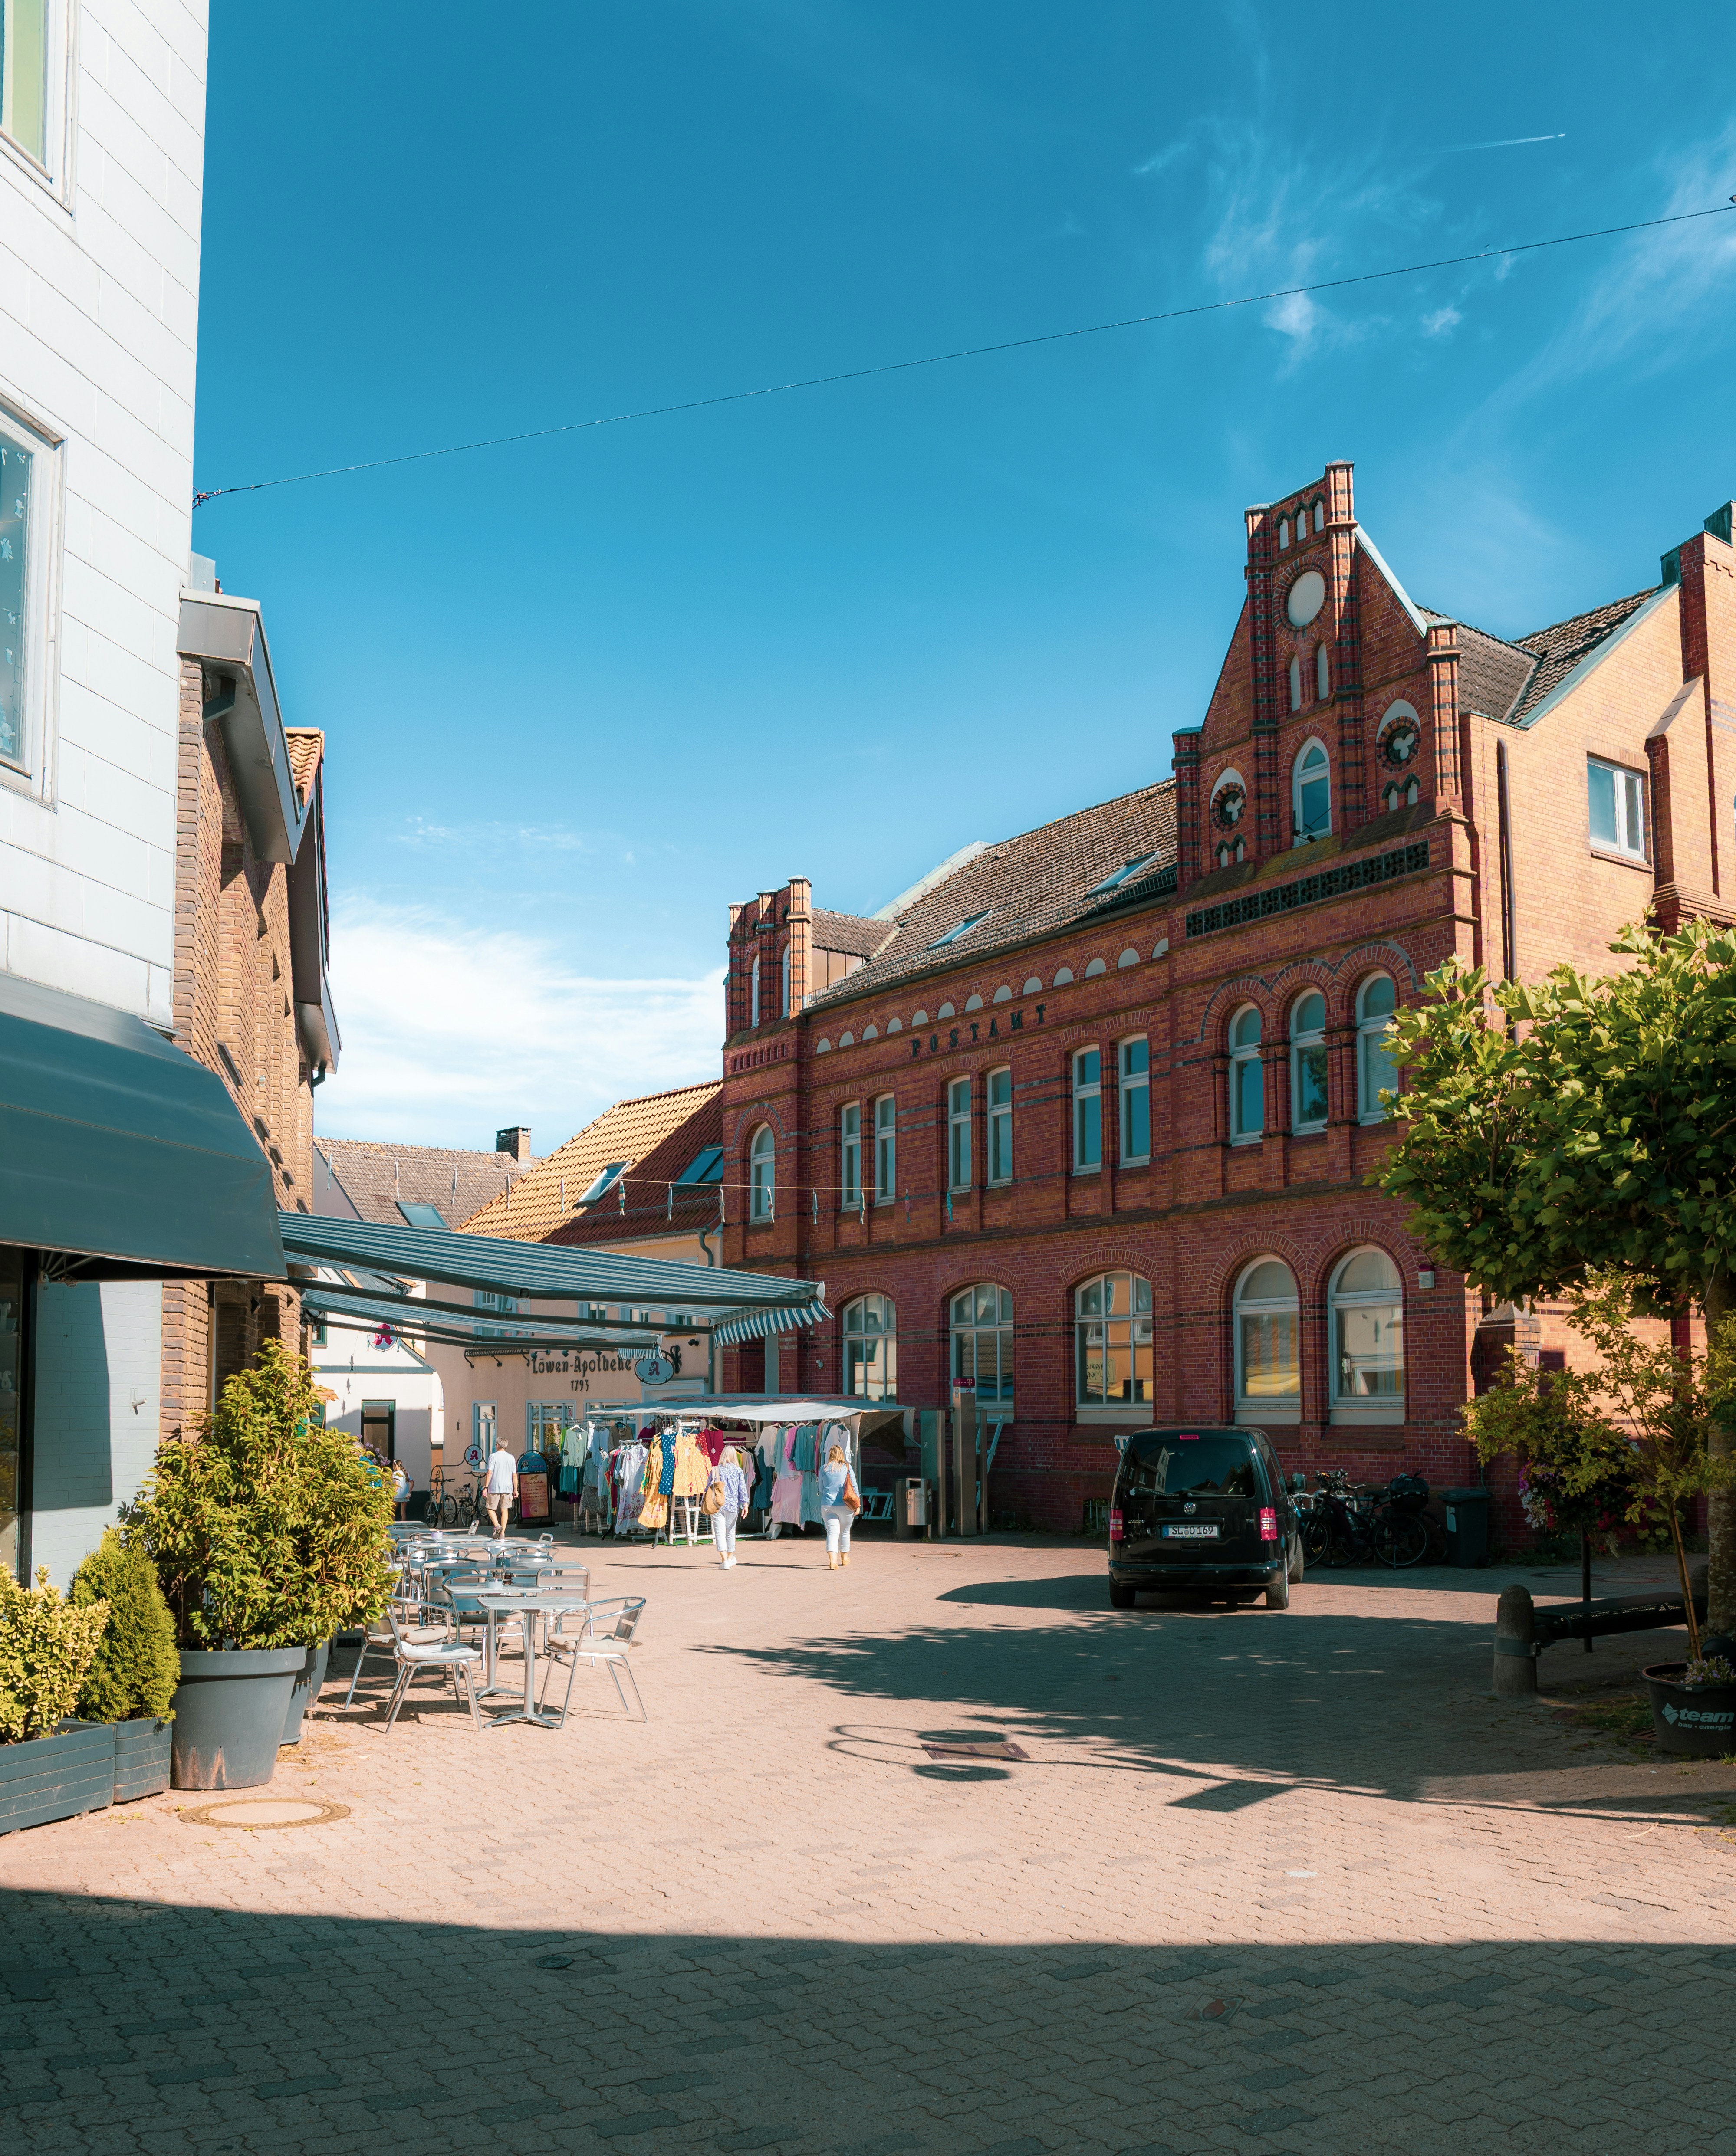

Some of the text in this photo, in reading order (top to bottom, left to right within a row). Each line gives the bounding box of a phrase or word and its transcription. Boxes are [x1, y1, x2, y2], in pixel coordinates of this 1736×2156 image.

[911, 1004, 1046, 1057] POSTAMT
[531, 1354, 631, 1378] Löwen-Apotheke
[570, 1379, 589, 1392] 1793
[1172, 1526, 1184, 1535] SL
[1197, 1526, 1213, 1535] 169
[1679, 1708, 1735, 1723] team
